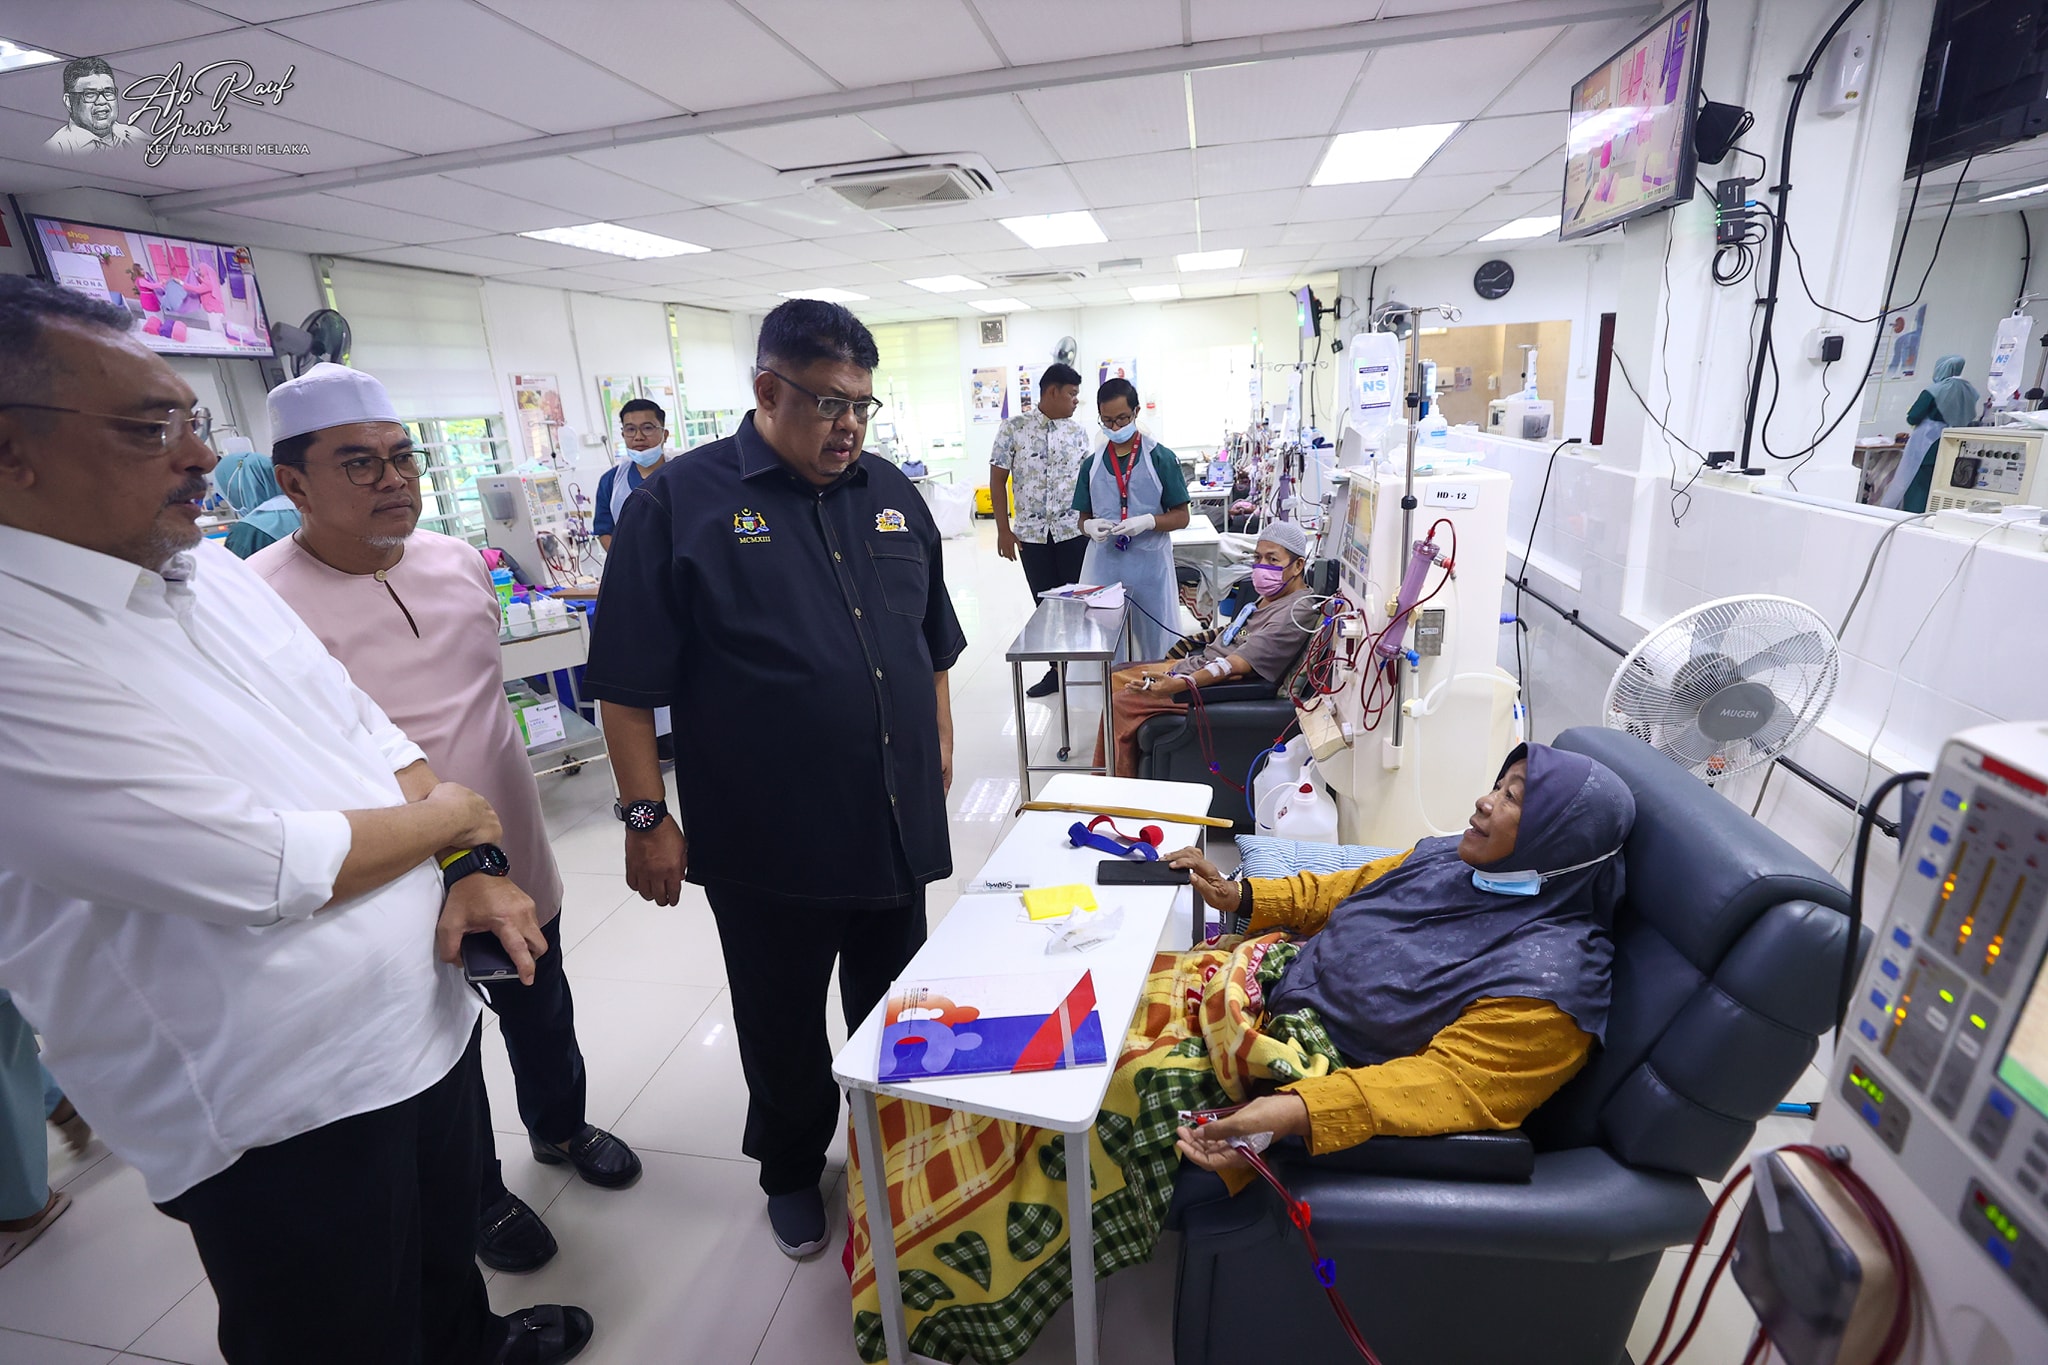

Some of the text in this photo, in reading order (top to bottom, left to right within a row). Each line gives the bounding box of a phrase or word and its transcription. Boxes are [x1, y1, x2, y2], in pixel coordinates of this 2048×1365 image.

[75, 280, 103, 288] NONA
[1363, 380, 1387, 393] NS
[1437, 491, 1449, 499] HD
[739, 536, 771, 544] MCMXIII
[1720, 708, 1758, 718] MUGEN
